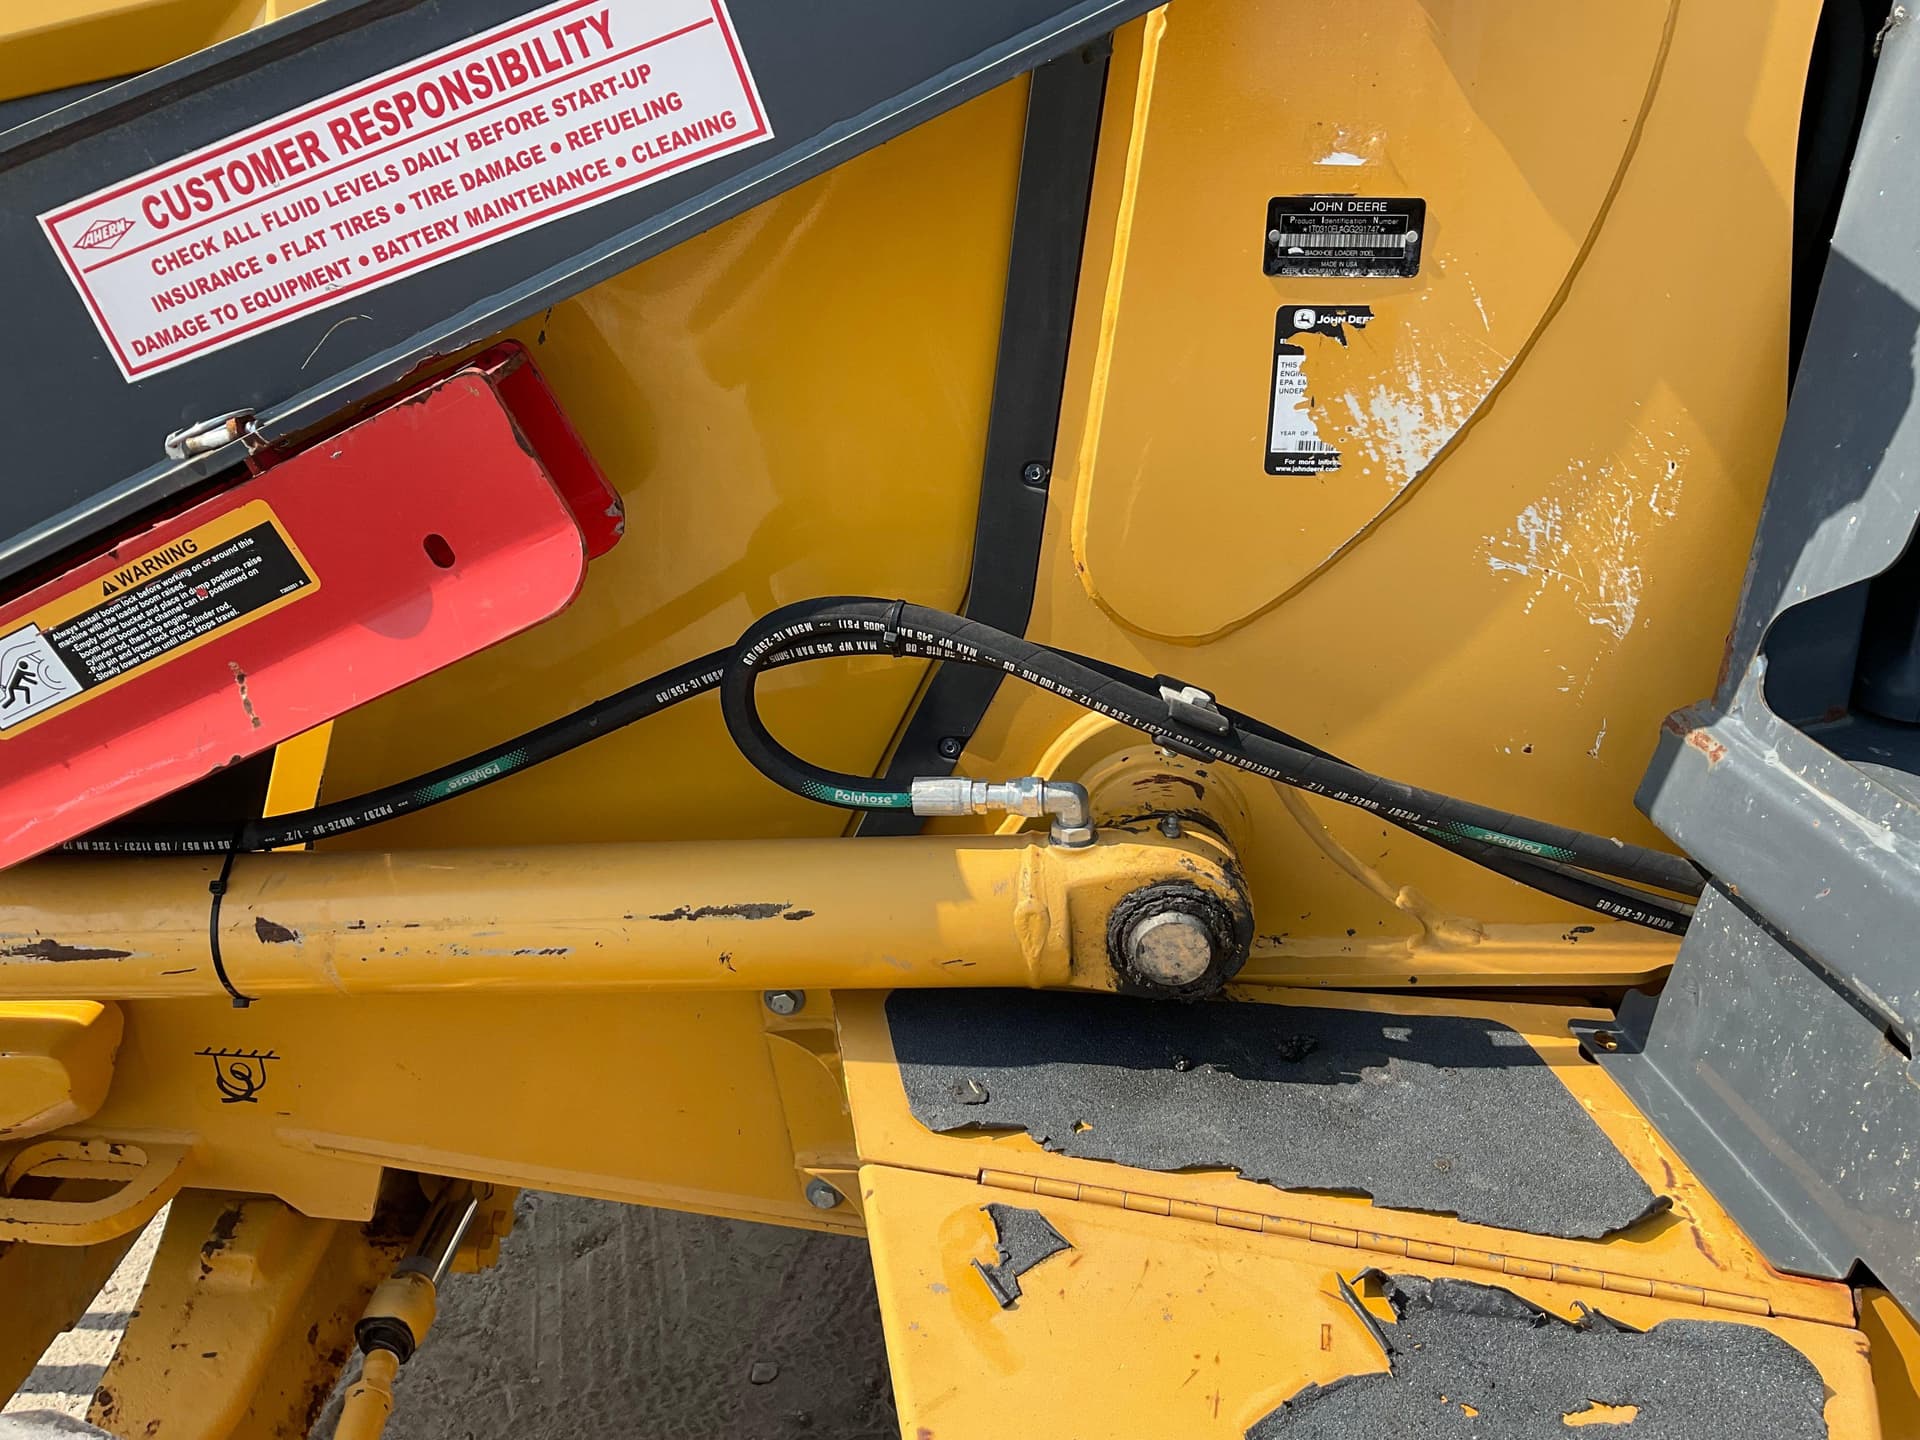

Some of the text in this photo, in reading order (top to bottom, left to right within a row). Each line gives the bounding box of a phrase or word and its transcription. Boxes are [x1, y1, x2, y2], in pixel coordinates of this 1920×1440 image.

[142, 10, 613, 229] CUSTOMER RESPONSIBILITY
[152, 64, 650, 275] CHECK ALL FLUID LEVELS DAILY BEFORE START-UP
[152, 93, 682, 312] INSURANCE FLAT TIRES TIRE DAMAGE REFUELING
[84, 218, 127, 249] AHERN
[132, 111, 736, 356] DAMAGE TO EQUIPMENT BATTERY MAINTENANCE CLEANING
[1290, 216, 1399, 225] Product Identification Number
[1310, 202, 1388, 212] JOHN DEERE
[1317, 315, 1346, 325] JOHN
[1280, 361, 1298, 369] THIS
[52, 626, 78, 641] Always
[77, 616, 101, 628] install
[99, 605, 122, 617] boom
[120, 596, 138, 607] lock
[136, 583, 161, 599] before
[161, 569, 192, 586] working
[192, 564, 202, 572] on
[212, 544, 239, 562] around
[238, 538, 254, 549] this
[114, 539, 197, 586] WARNING
[58, 631, 88, 648] machine
[88, 622, 104, 633] with
[103, 617, 117, 625] the
[115, 605, 139, 619] loader
[139, 594, 161, 608] boom
[161, 581, 186, 597] raised.
[79, 646, 101, 659] boom
[100, 636, 118, 648] until
[116, 627, 139, 640] boom
[137, 619, 155, 630] lock
[155, 603, 184, 622] channel
[184, 598, 198, 608] can
[208, 572, 248, 597] positioned
[248, 568, 259, 576] on
[96, 625, 120, 640] loader
[119, 612, 146, 629] bucket
[145, 604, 160, 616] and
[160, 596, 180, 611] place
[210, 567, 243, 586] position,
[243, 556, 262, 568] raise
[86, 613, 190, 666] cylinder rod, then stop engine.
[106, 657, 118, 668] pin
[118, 649, 133, 660] and
[131, 640, 152, 653] lower
[152, 632, 169, 643] lock
[169, 624, 186, 635] onto
[186, 610, 215, 627] cylinder
[216, 602, 232, 613] rod.
[119, 656, 140, 669] lower
[139, 646, 162, 659] boom
[162, 636, 179, 649] until
[178, 629, 195, 641] lock
[195, 620, 216, 633] stops
[215, 608, 240, 623] travel.
